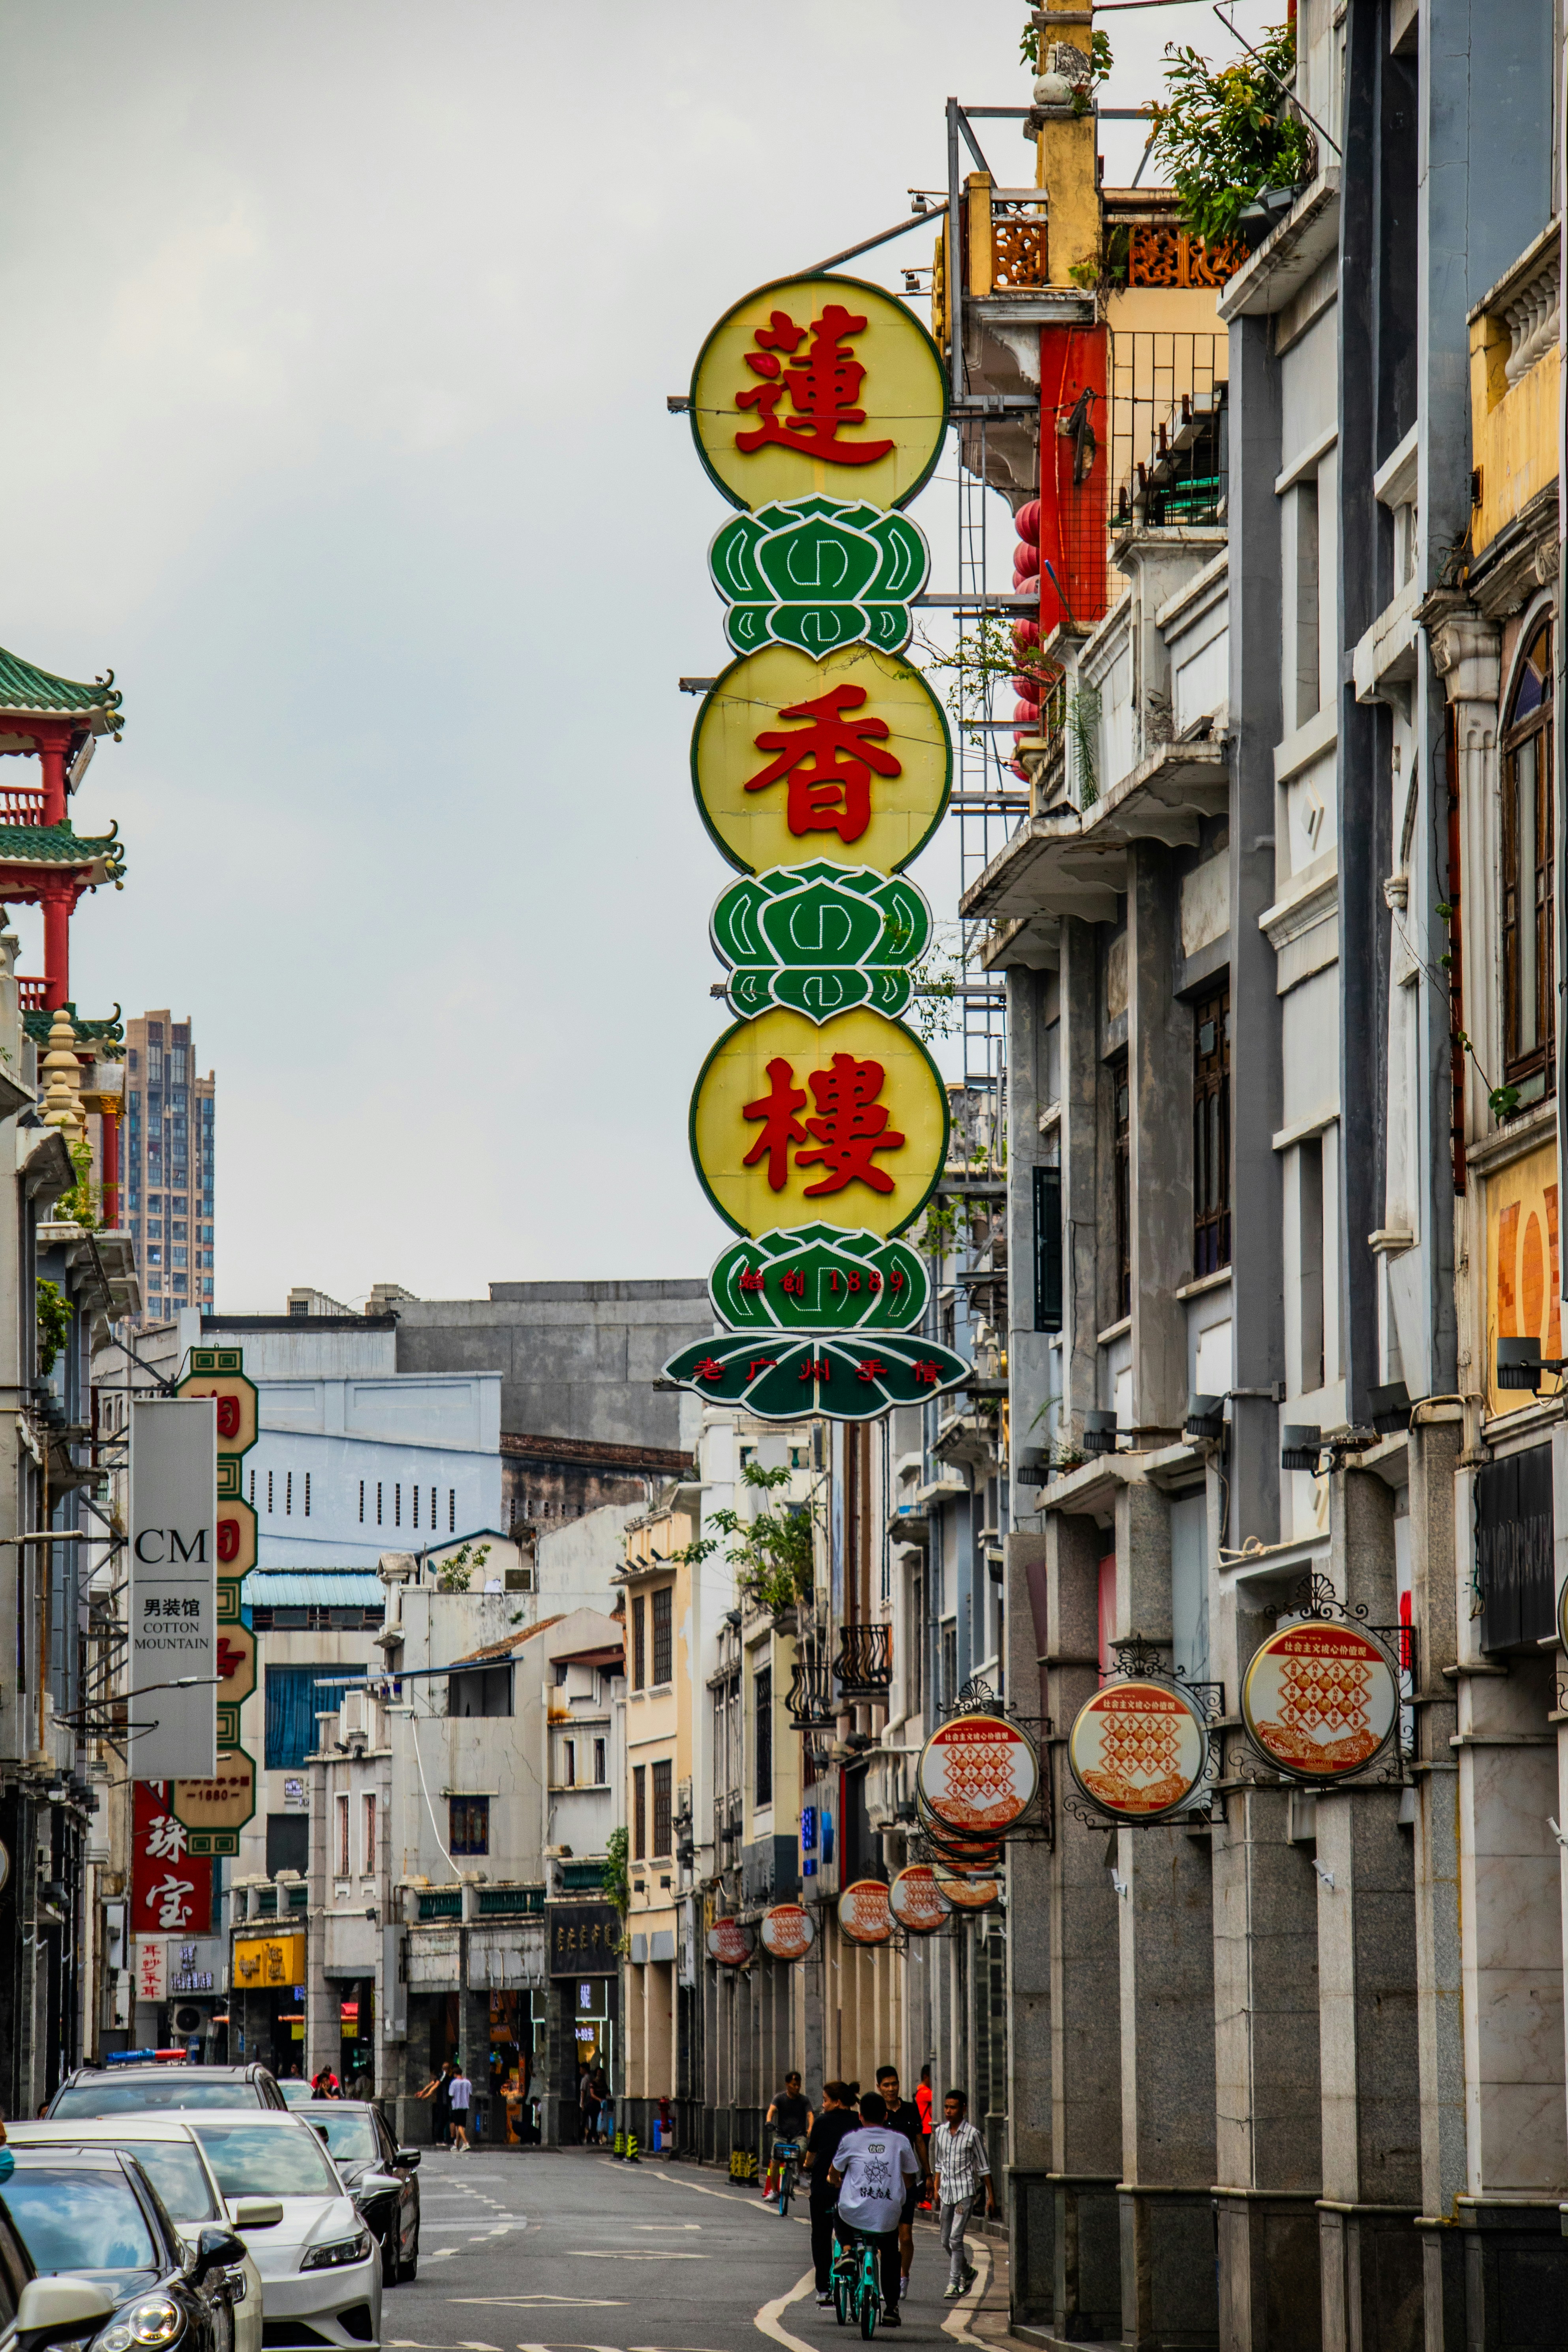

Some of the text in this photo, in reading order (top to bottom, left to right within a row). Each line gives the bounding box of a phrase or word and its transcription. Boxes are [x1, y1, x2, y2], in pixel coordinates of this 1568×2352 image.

[694, 1356, 943, 1384] 老广州手信
[135, 1529, 209, 1563] CM
[144, 1599, 200, 1617] 男装馆
[143, 1622, 199, 1634] COTTON
[135, 1638, 209, 1650] MOUNTAIN
[1284, 1640, 1367, 1657] 社会主义核心价值观
